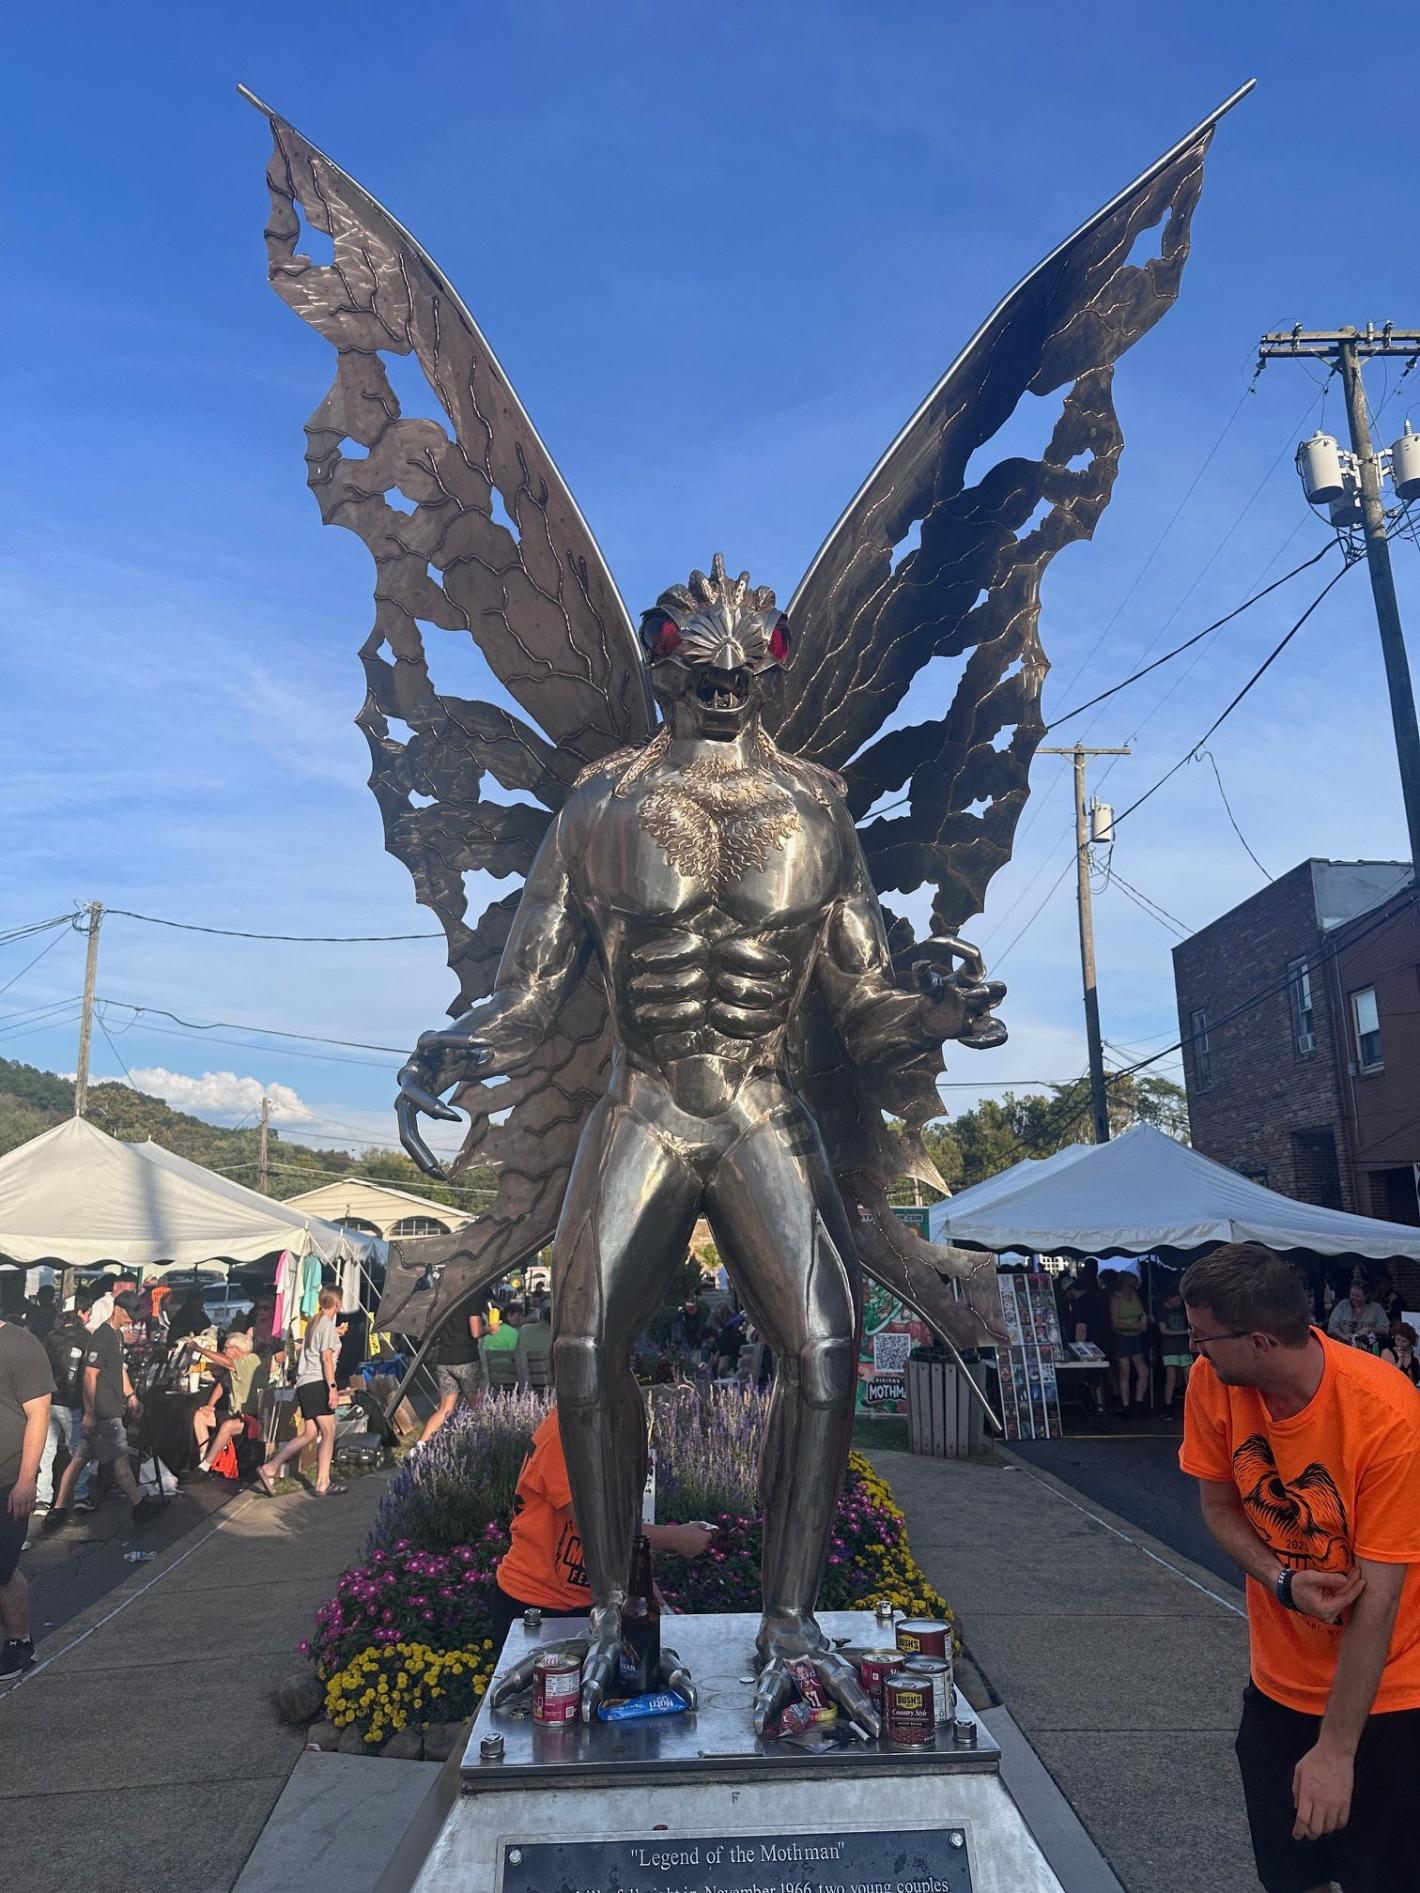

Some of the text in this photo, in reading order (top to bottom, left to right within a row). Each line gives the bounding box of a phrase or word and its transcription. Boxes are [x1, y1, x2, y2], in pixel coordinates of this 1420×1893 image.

[897, 1695, 922, 1705] BUSH'S
[892, 1708, 928, 1718] Country Style
[631, 1841, 845, 1870] "Legend of the Mothman"
[780, 1880, 812, 1893] 1966
[818, 1882, 845, 1893] two
[850, 1881, 891, 1893] young
[896, 1877, 949, 1893] couples
